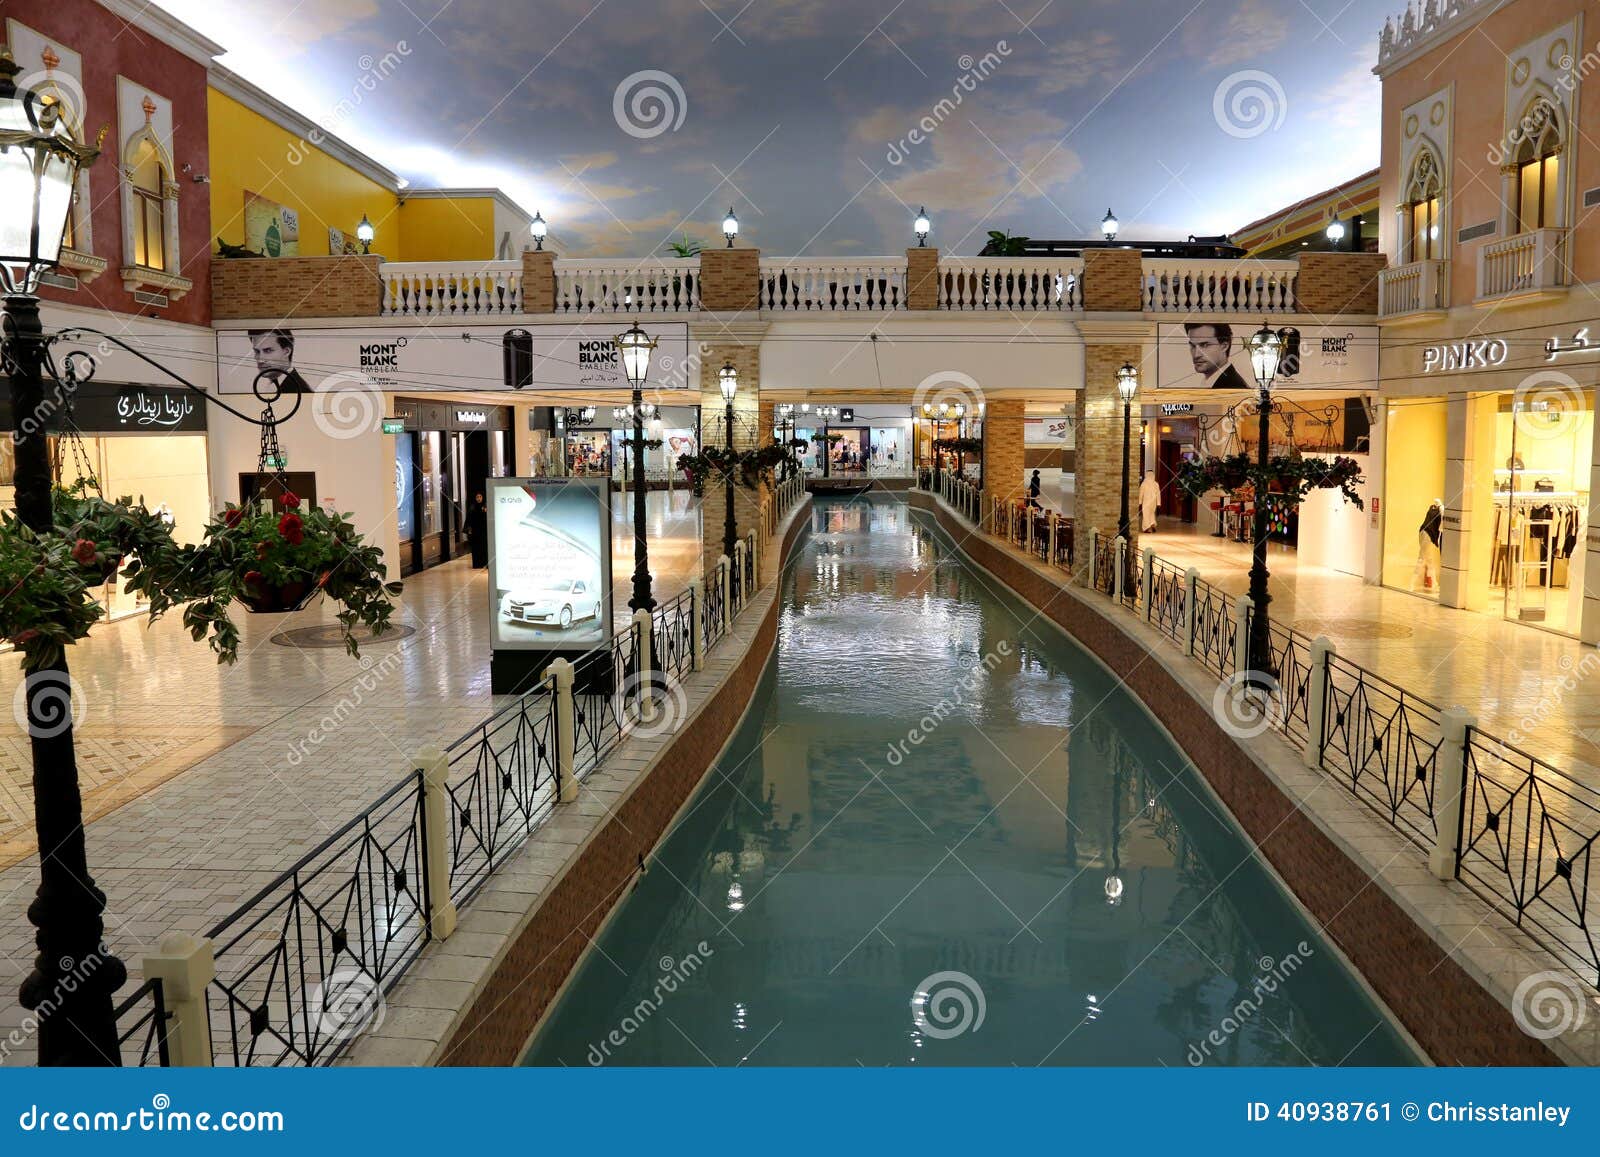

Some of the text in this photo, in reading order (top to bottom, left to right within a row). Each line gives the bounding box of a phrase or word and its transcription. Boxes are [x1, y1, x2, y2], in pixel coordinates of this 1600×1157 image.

[360, 344, 397, 355] MONT
[579, 341, 616, 351] MONT
[360, 355, 398, 366] BLANC
[579, 352, 618, 363] BLANC
[1424, 339, 1508, 373] PINKO
